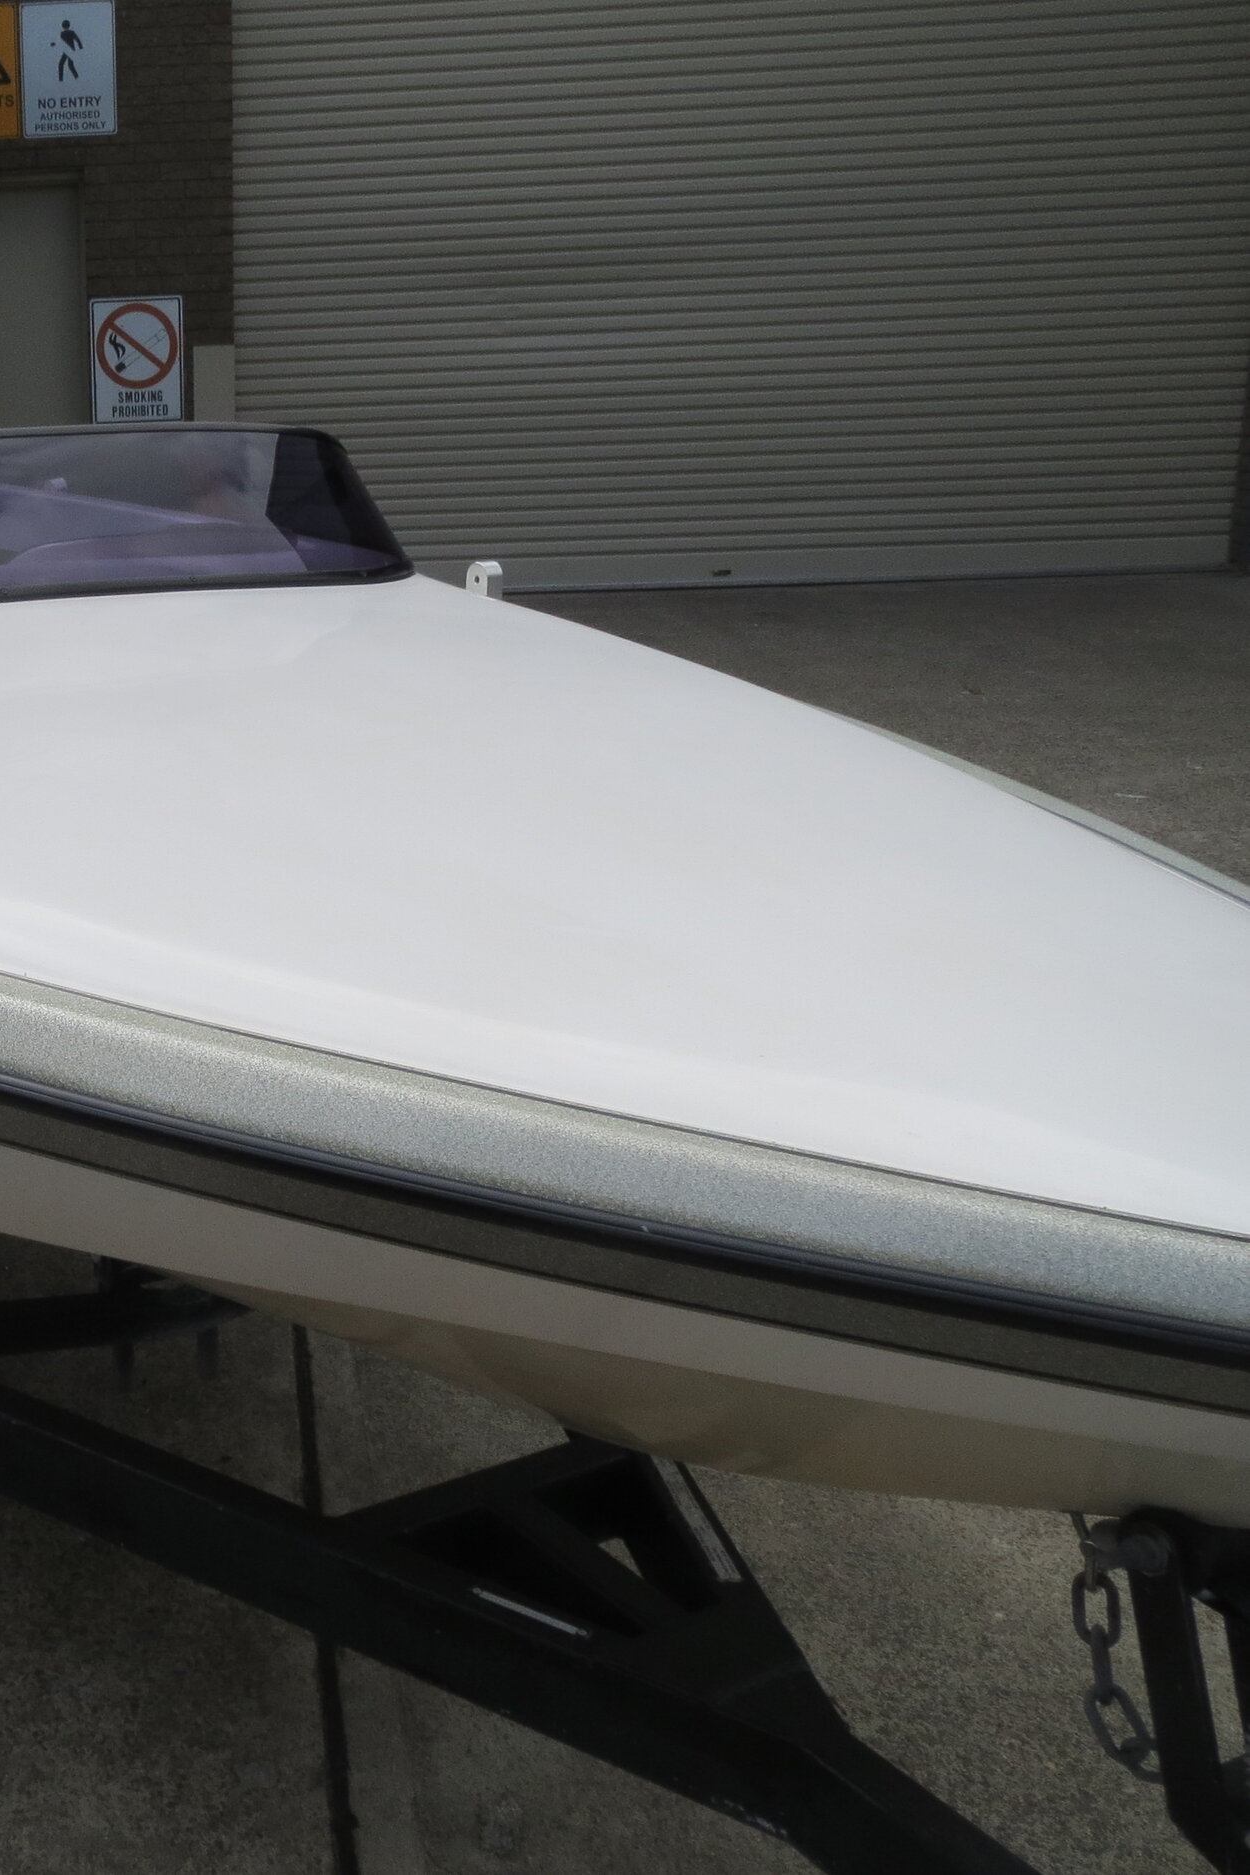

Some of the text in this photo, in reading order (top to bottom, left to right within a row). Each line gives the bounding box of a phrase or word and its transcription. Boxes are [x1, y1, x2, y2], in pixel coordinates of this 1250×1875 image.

[38, 96, 102, 109] NO ENTRY
[40, 110, 101, 121] AUTHORISED
[34, 121, 107, 133] PERSONS ONLY
[118, 390, 163, 403] SMOKING
[112, 404, 168, 418] PROHIBITED
